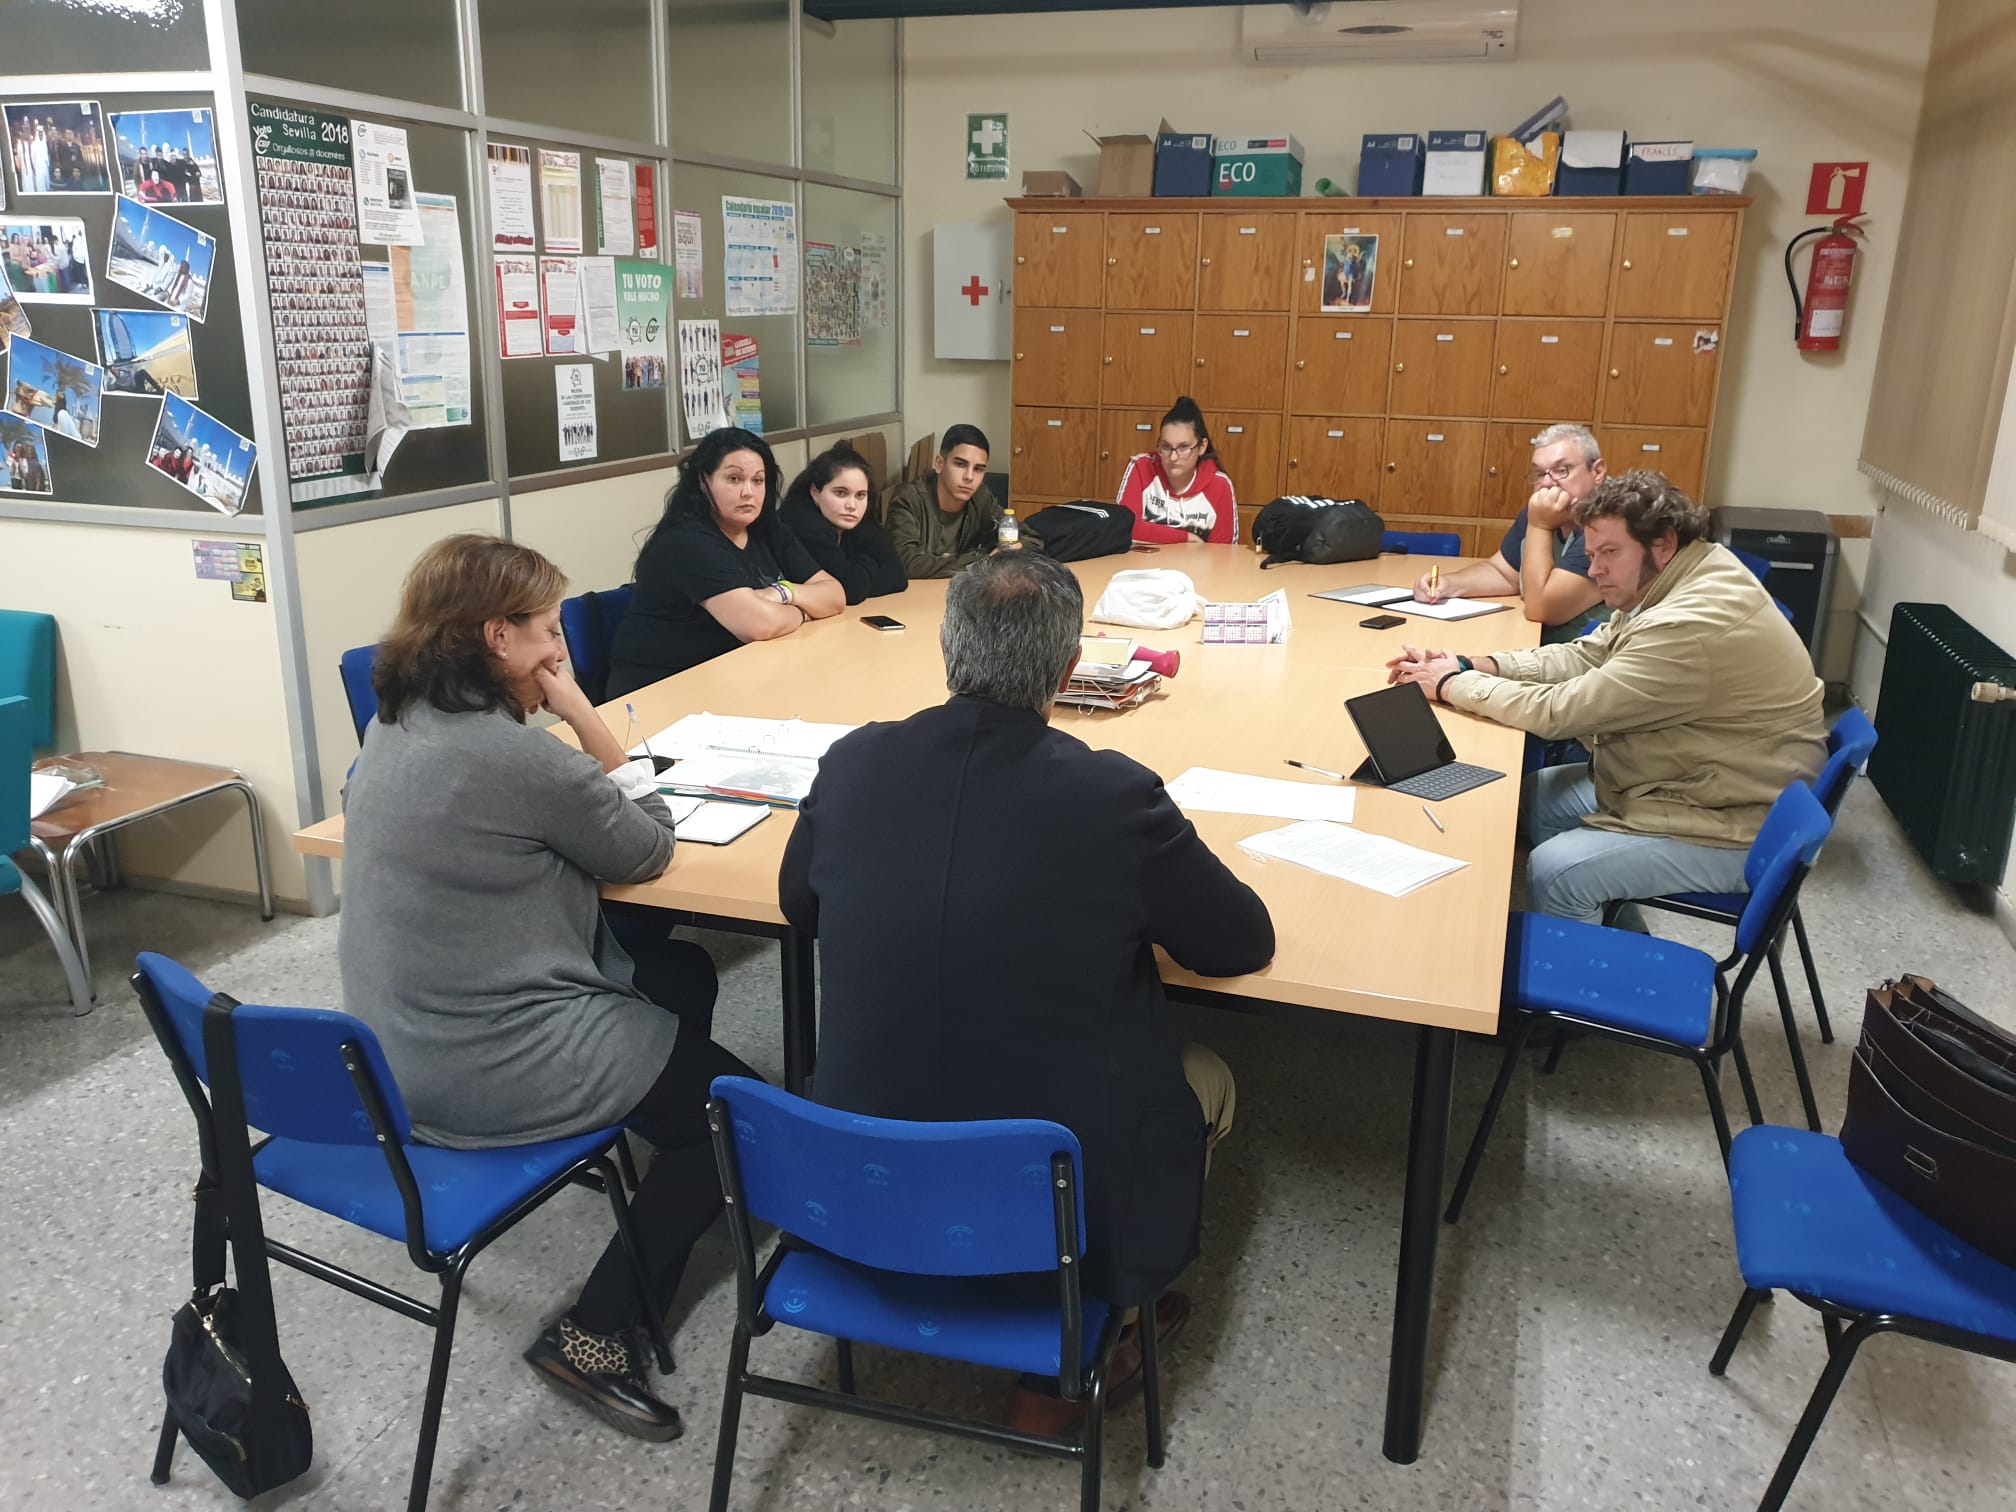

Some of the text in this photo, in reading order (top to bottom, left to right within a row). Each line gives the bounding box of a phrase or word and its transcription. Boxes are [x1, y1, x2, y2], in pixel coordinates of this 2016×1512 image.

[251, 103, 315, 126] Candidatura
[282, 123, 317, 141] Sevilla
[321, 121, 349, 145] 2018
[1218, 140, 1237, 151] ECO
[1219, 161, 1256, 183] ECO
[622, 273, 662, 289] TU VOTO
